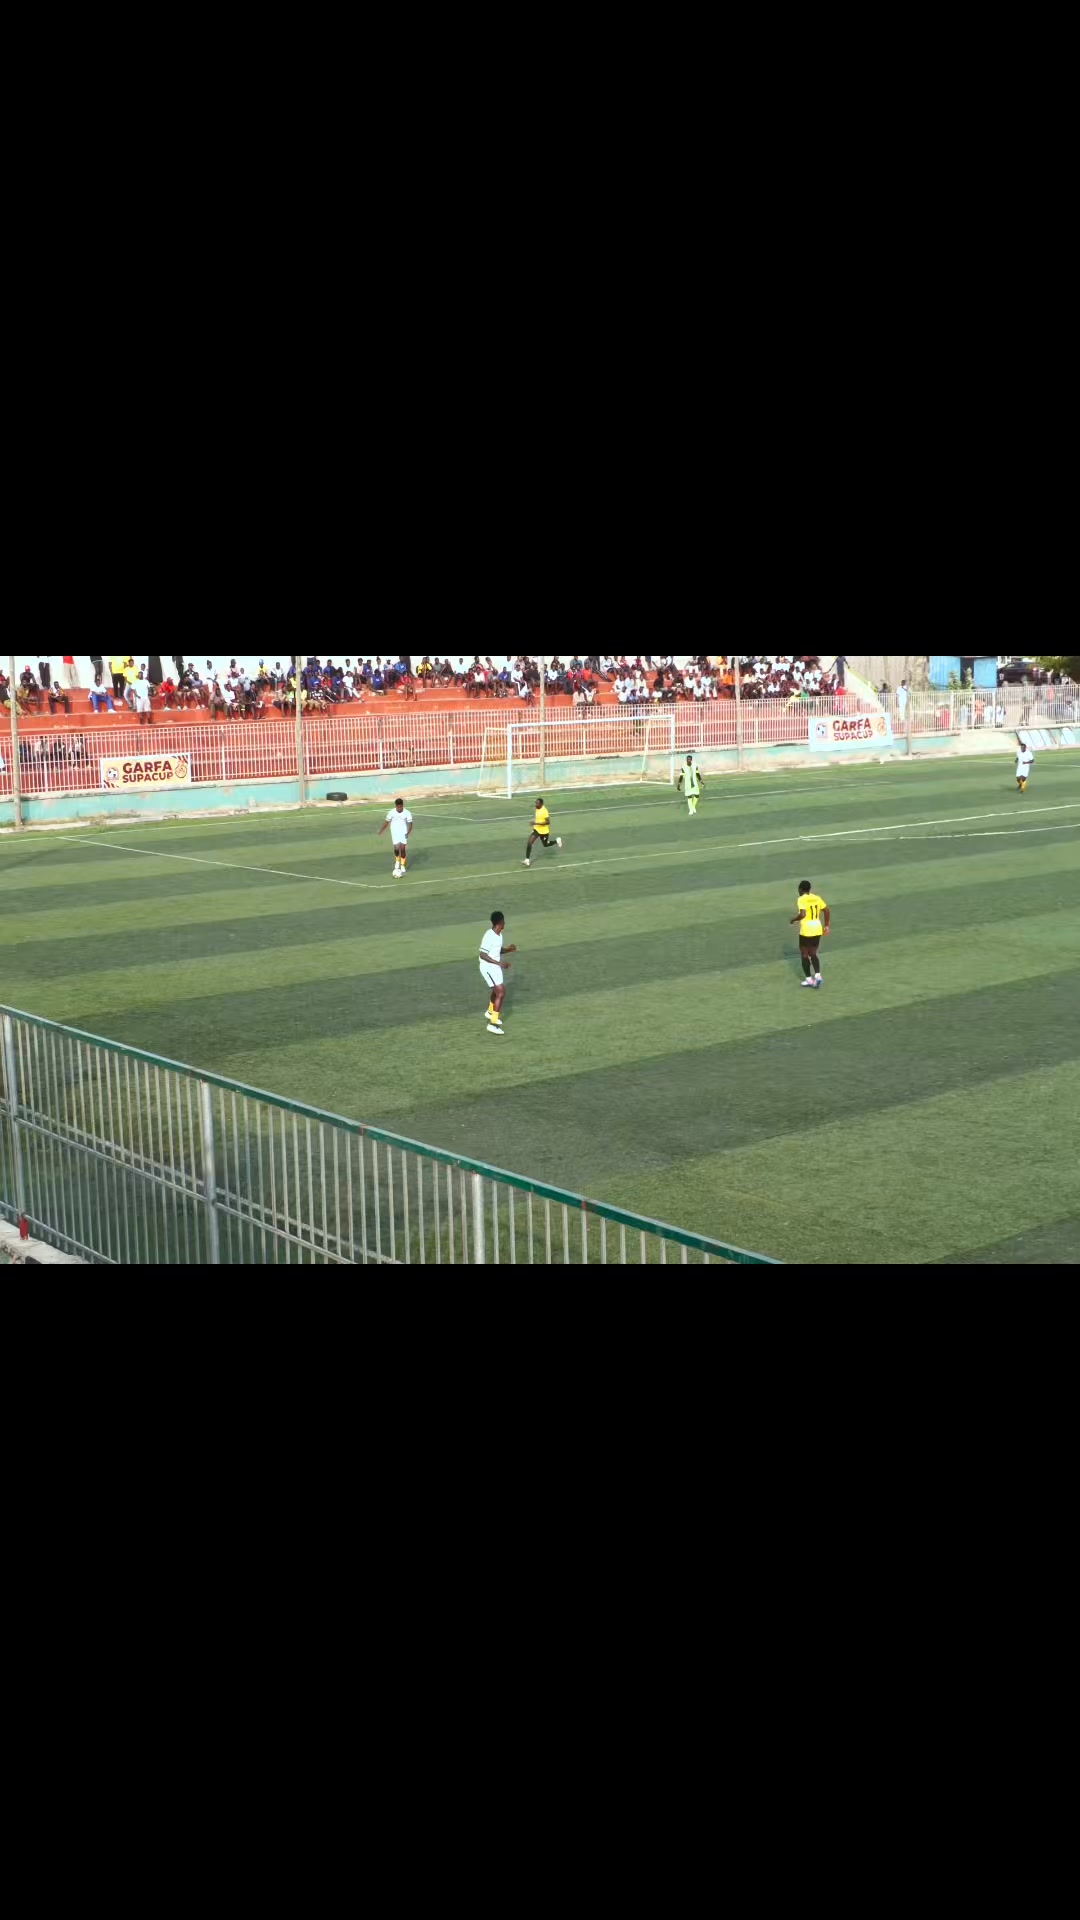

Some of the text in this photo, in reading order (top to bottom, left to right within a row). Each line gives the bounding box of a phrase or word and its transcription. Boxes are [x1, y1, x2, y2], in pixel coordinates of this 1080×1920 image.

[833, 718, 871, 732] GARFA
[833, 730, 873, 741] SUPACUP
[123, 761, 172, 774] GARFA
[122, 772, 174, 783] SUPACUP
[810, 905, 818, 920] 11
